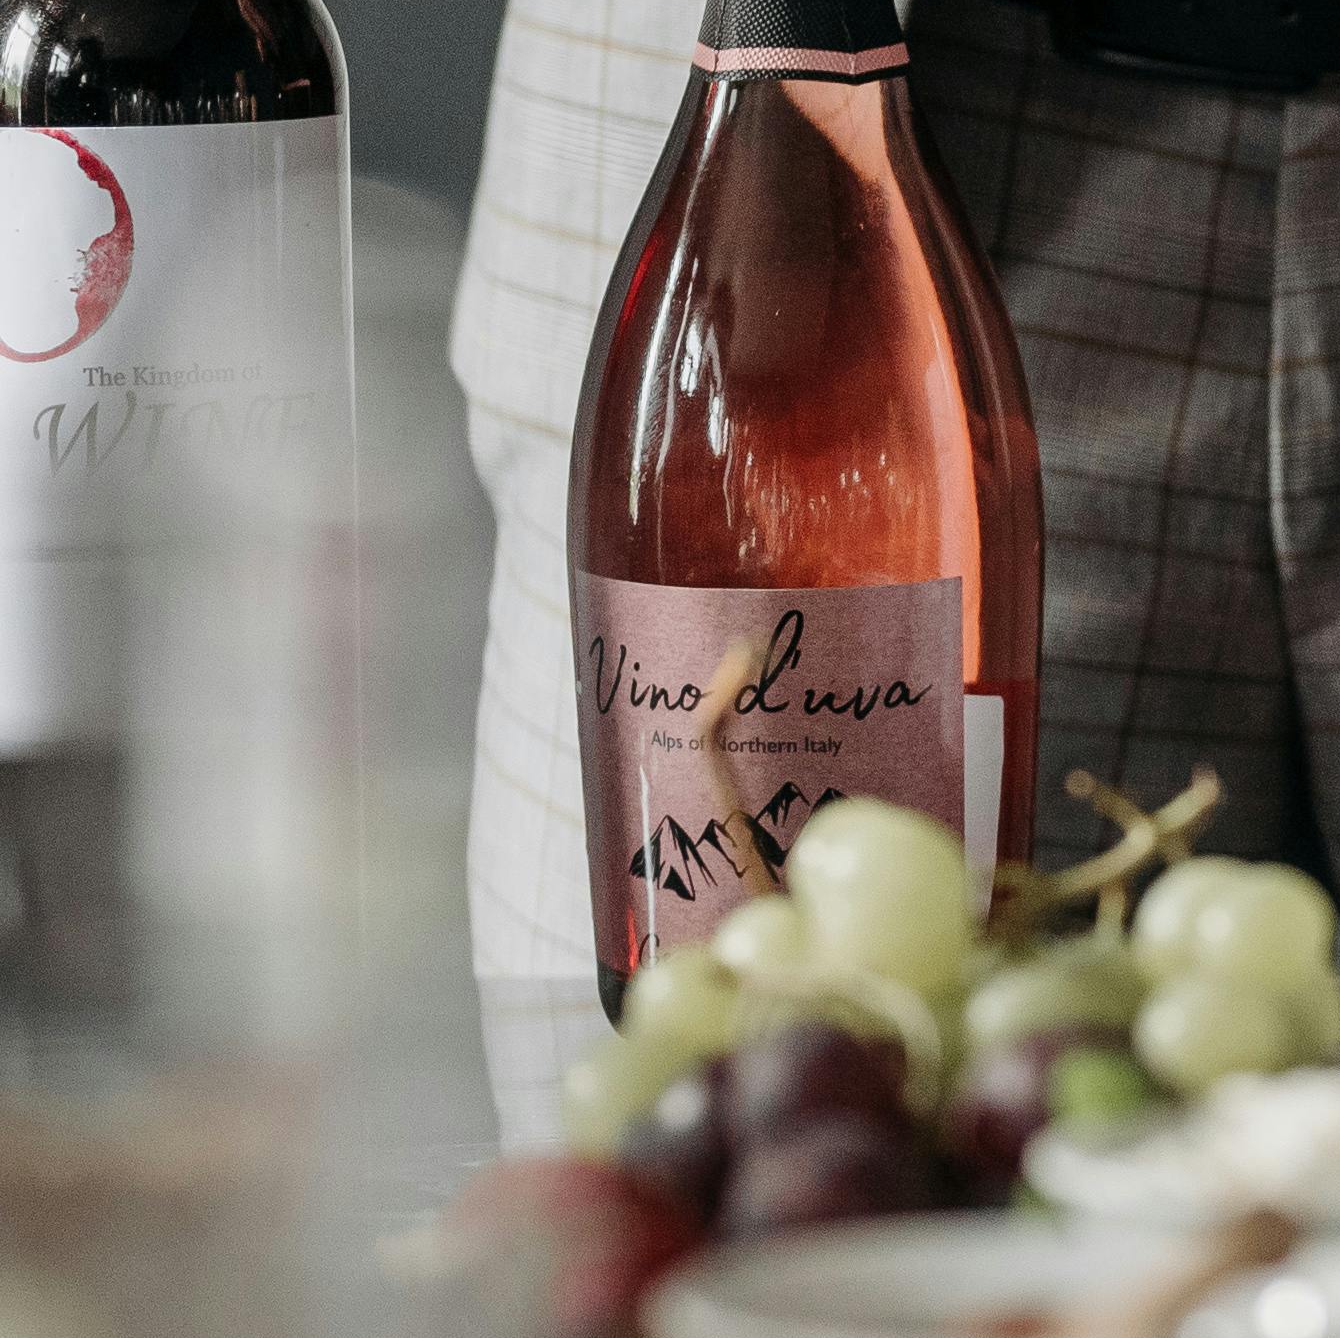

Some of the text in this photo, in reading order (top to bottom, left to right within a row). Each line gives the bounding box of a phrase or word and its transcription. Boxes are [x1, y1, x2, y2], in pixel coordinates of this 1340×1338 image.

[83, 366, 127, 387] The
[131, 363, 236, 388] Kingdom
[588, 634, 713, 716] Vino
[651, 730, 683, 753] Alps
[804, 736, 843, 757] Italy
